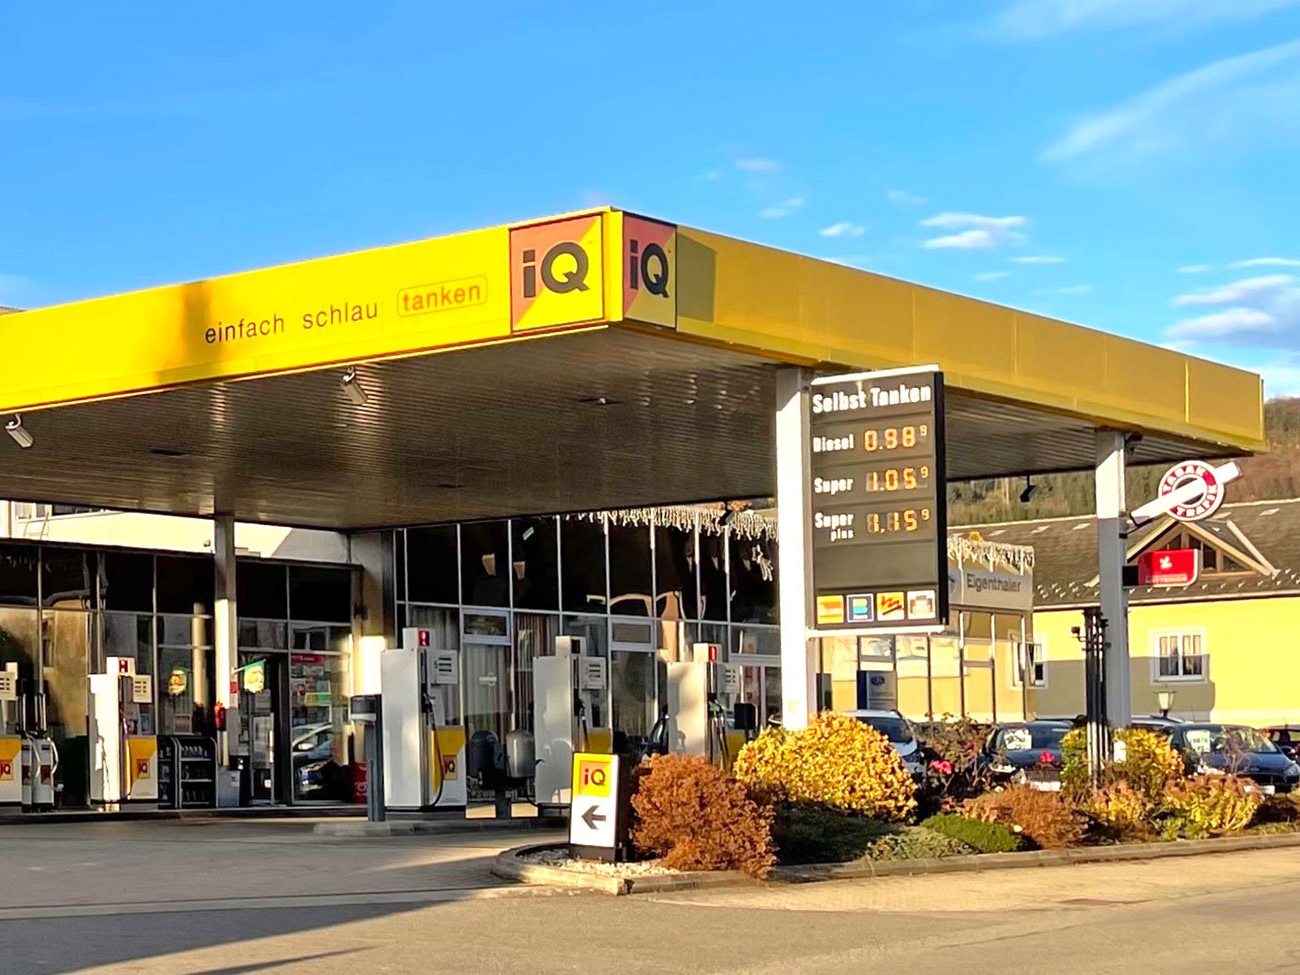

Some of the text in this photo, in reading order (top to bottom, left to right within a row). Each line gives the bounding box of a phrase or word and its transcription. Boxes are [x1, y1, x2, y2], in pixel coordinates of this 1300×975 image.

[522, 241, 590, 298] iQ
[629, 239, 670, 298] iQ
[205, 284, 481, 344] einfach schlau tanken
[812, 384, 931, 414] Selbst Tanken
[813, 433, 854, 453] Diesel
[814, 477, 854, 496] Super
[814, 512, 854, 530] Super
[830, 528, 854, 542] plus
[584, 768, 606, 787] iQ
